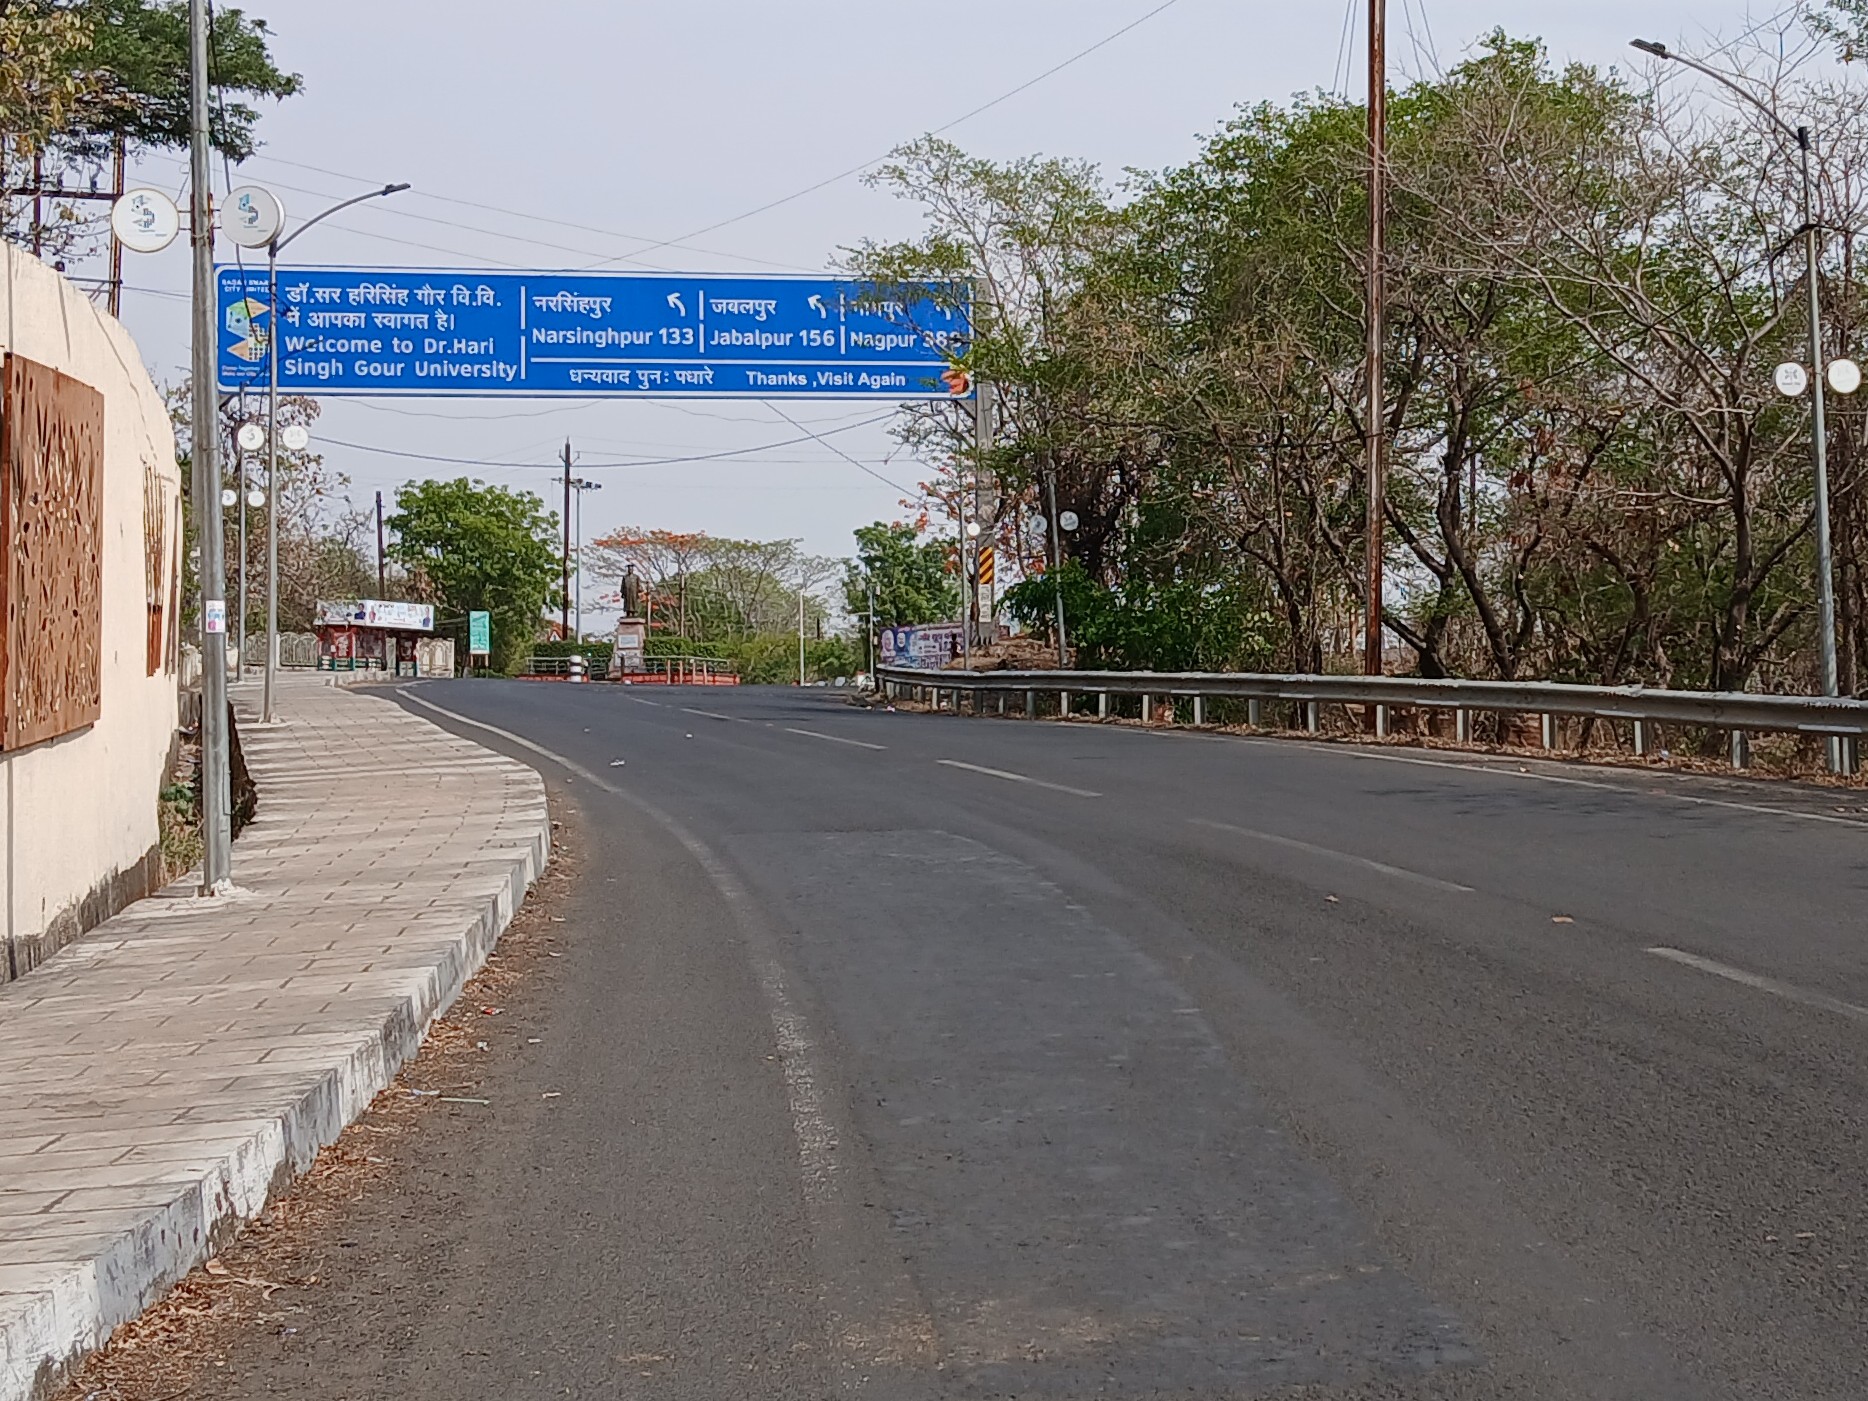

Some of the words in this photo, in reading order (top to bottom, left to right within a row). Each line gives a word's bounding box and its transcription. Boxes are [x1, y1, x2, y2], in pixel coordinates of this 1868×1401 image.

[346, 282, 409, 306] हरिसिंह
[413, 283, 446, 306] गौर
[532, 291, 612, 319] नरसिंहपुर
[307, 312, 366, 329] आपका
[371, 312, 429, 330] स्वागत
[391, 336, 413, 354] to
[424, 337, 494, 355] Dr.Hari
[532, 326, 653, 348] Narsinghpur
[659, 327, 694, 345] 133
[709, 328, 794, 350] Jabalpur
[799, 329, 835, 347] 156
[850, 331, 917, 352] Nagpur
[284, 357, 343, 380] Singh
[354, 359, 405, 377] Gour
[415, 360, 517, 382] University
[569, 368, 631, 385] धन्यवाद
[673, 365, 715, 385] पधारे
[745, 370, 808, 386] Thanks
[857, 371, 906, 389] Again
